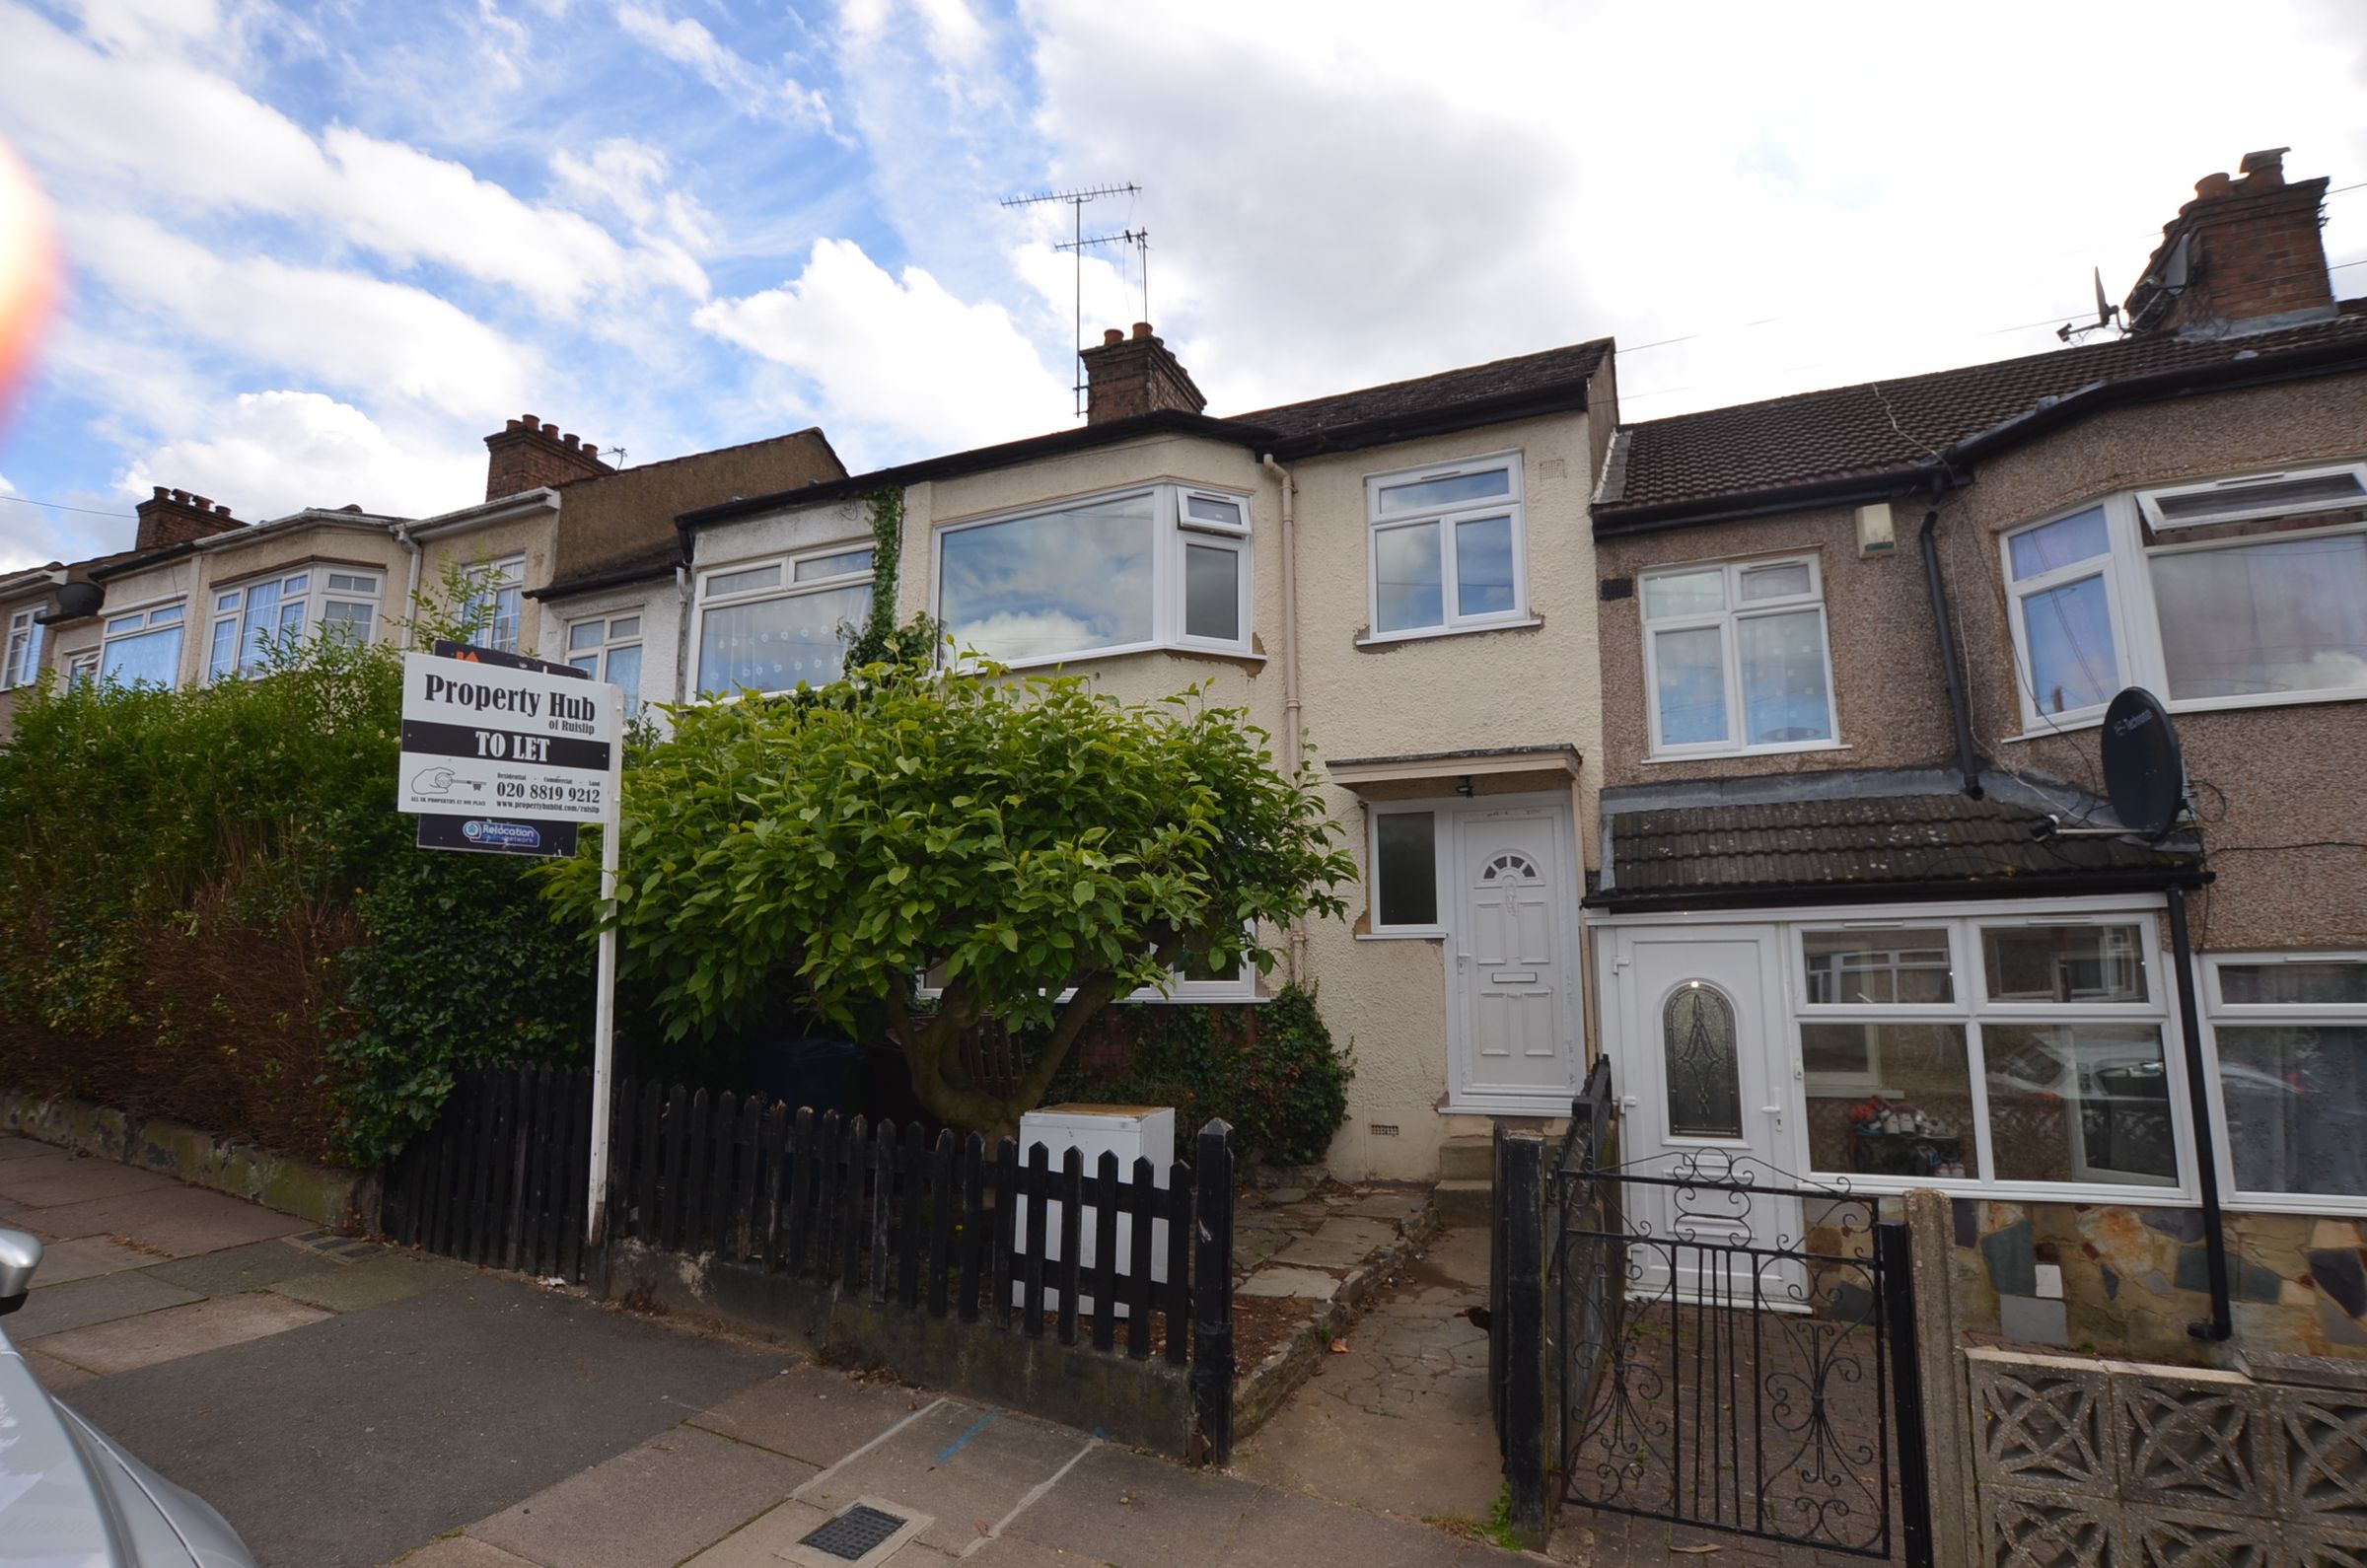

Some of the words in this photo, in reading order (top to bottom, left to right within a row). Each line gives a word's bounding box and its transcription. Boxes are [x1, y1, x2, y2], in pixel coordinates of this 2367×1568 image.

[424, 674, 540, 718] Property
[548, 691, 596, 722] Hub
[548, 720, 558, 730] of
[561, 721, 595, 735] Ruislip
[475, 731, 506, 757] TO
[512, 736, 550, 761] LET
[496, 782, 525, 798] 020
[530, 784, 563, 801] 8819
[568, 787, 600, 803] 9212
[482, 823, 535, 837] Relocation
